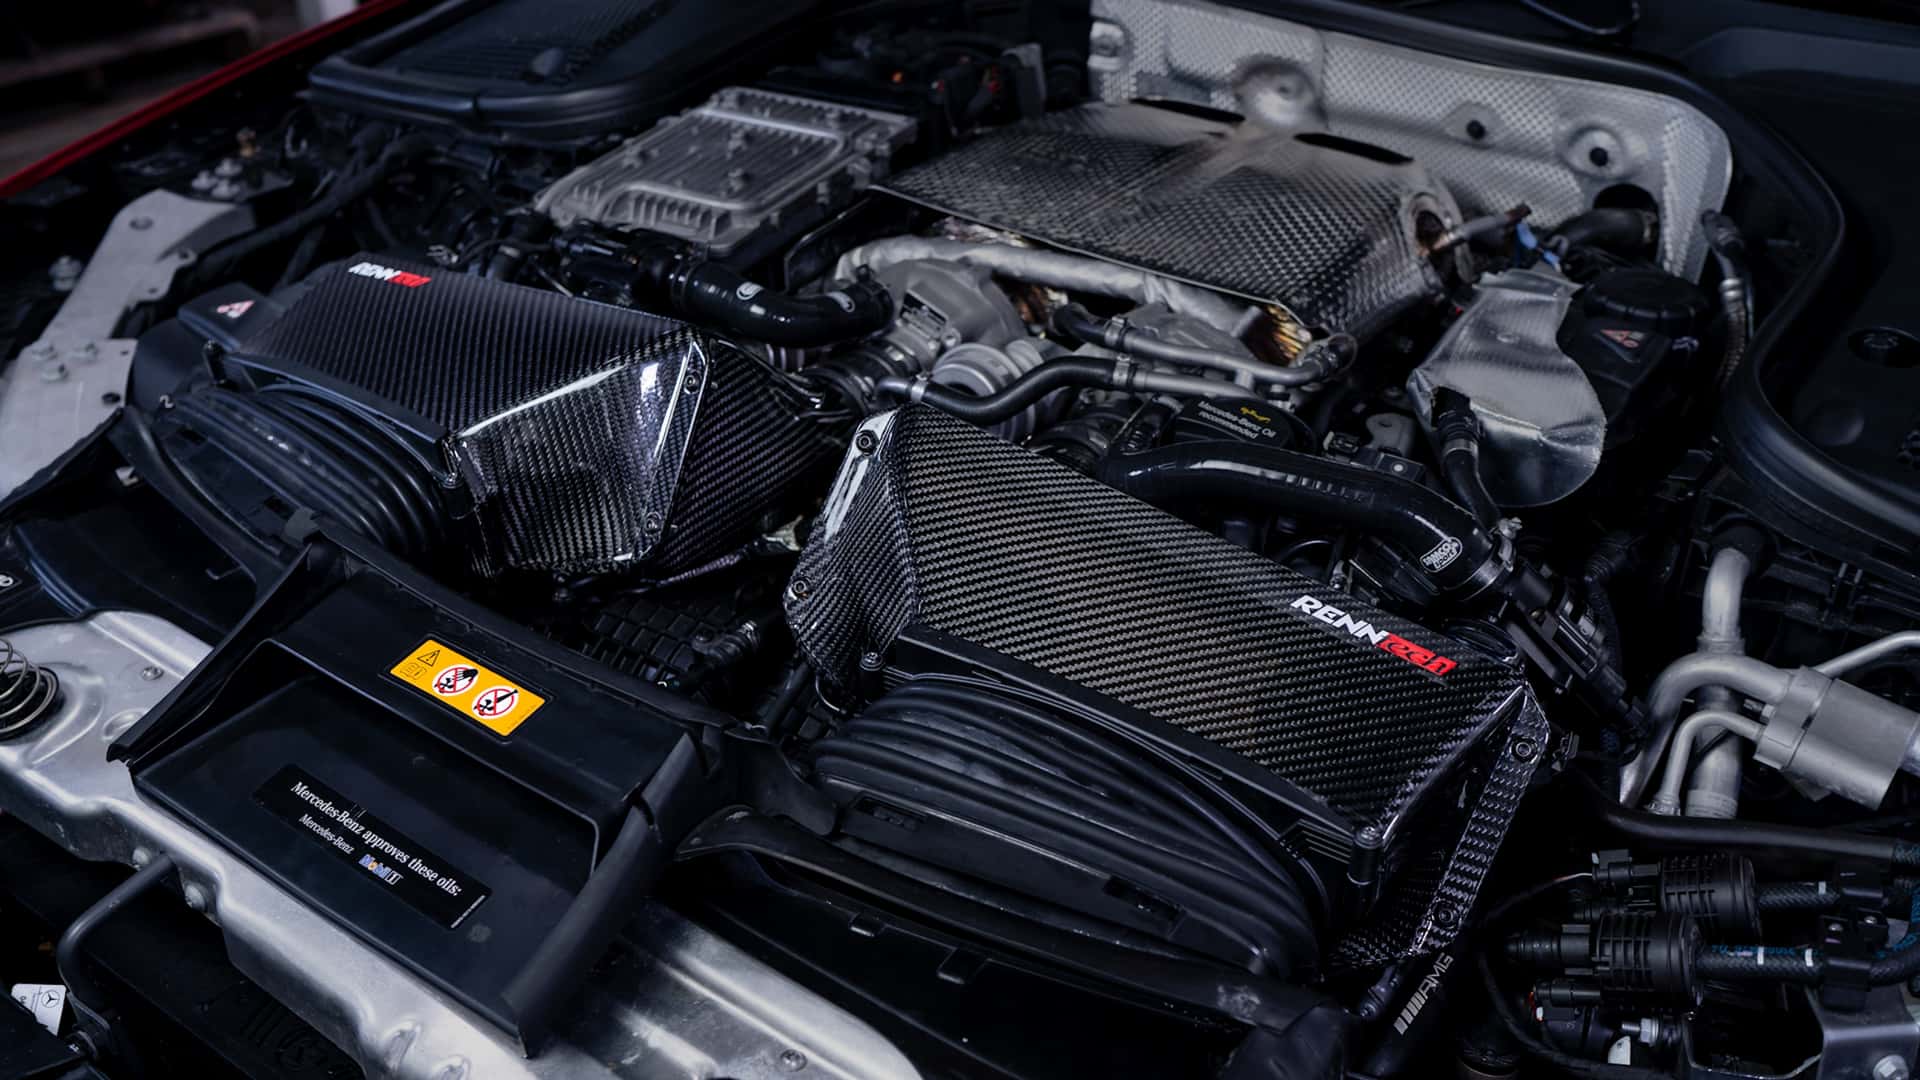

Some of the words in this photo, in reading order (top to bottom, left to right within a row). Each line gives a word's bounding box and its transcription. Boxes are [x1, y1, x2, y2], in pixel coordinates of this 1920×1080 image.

[290, 781, 366, 835] Mercedes-Benz
[361, 830, 410, 863] approves
[407, 857, 440, 882] these
[435, 876, 463, 897] oils:
[299, 812, 355, 855] Mercedes-Benz
